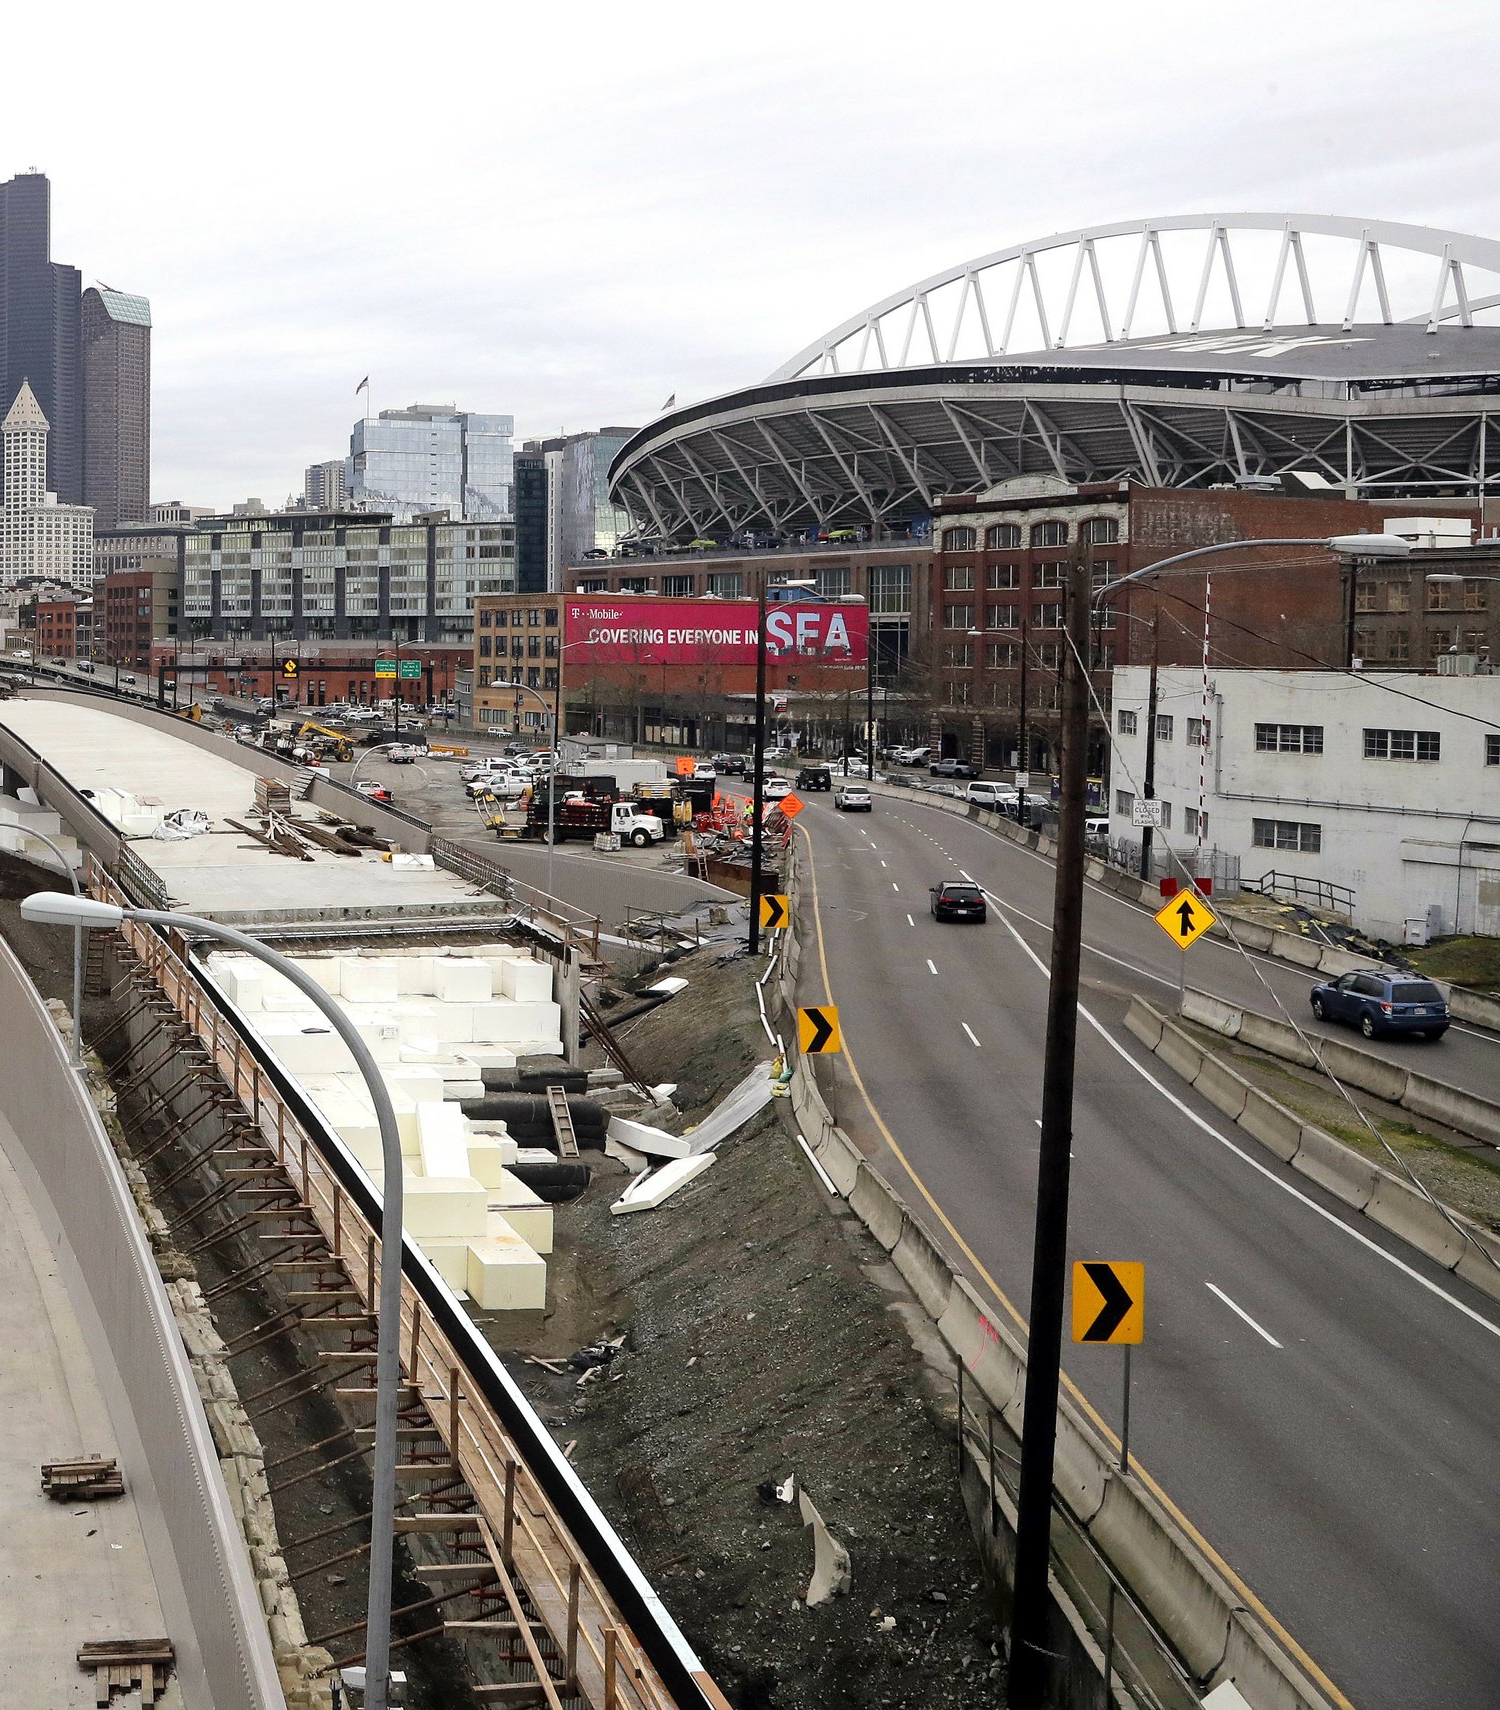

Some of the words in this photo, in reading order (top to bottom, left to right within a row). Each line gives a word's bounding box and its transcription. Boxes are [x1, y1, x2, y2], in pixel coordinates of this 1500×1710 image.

[588, 628, 664, 644] COVERING
[667, 629, 741, 644] EVERYONE
[744, 630, 758, 645] IN
[765, 611, 852, 656] SEA
